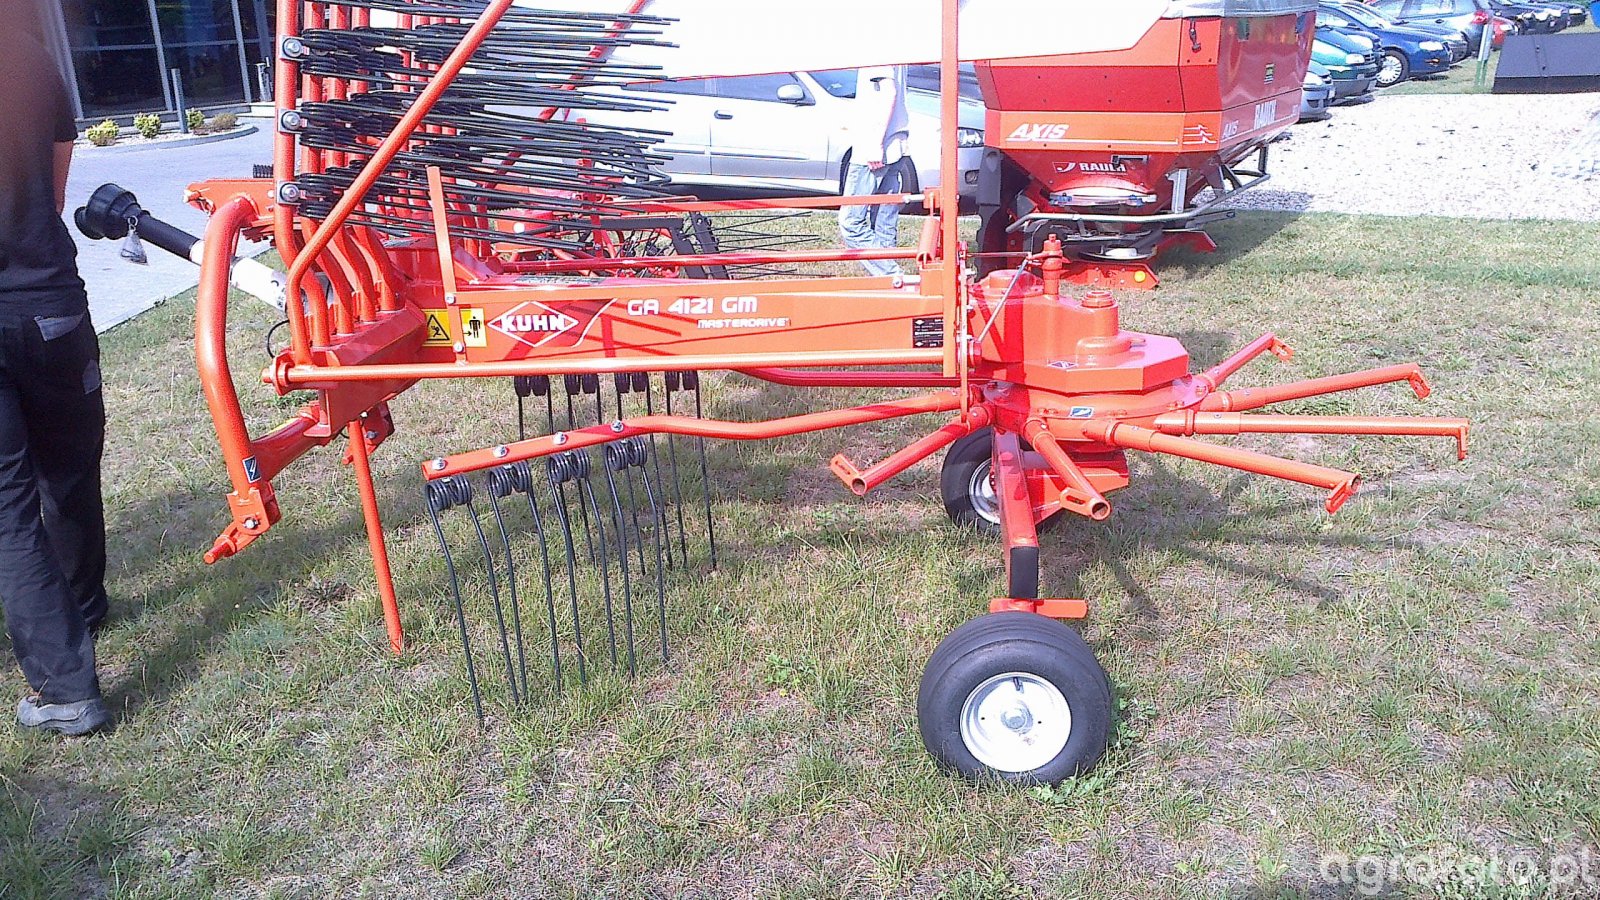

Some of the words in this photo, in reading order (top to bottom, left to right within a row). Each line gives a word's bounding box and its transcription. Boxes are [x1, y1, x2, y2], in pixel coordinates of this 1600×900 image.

[1008, 122, 1070, 140] AXIS
[627, 299, 660, 316] GA
[667, 297, 714, 315] 4121
[721, 296, 758, 314] GM
[501, 314, 566, 332] KUHN
[697, 317, 787, 329] MASTERDRIVE
